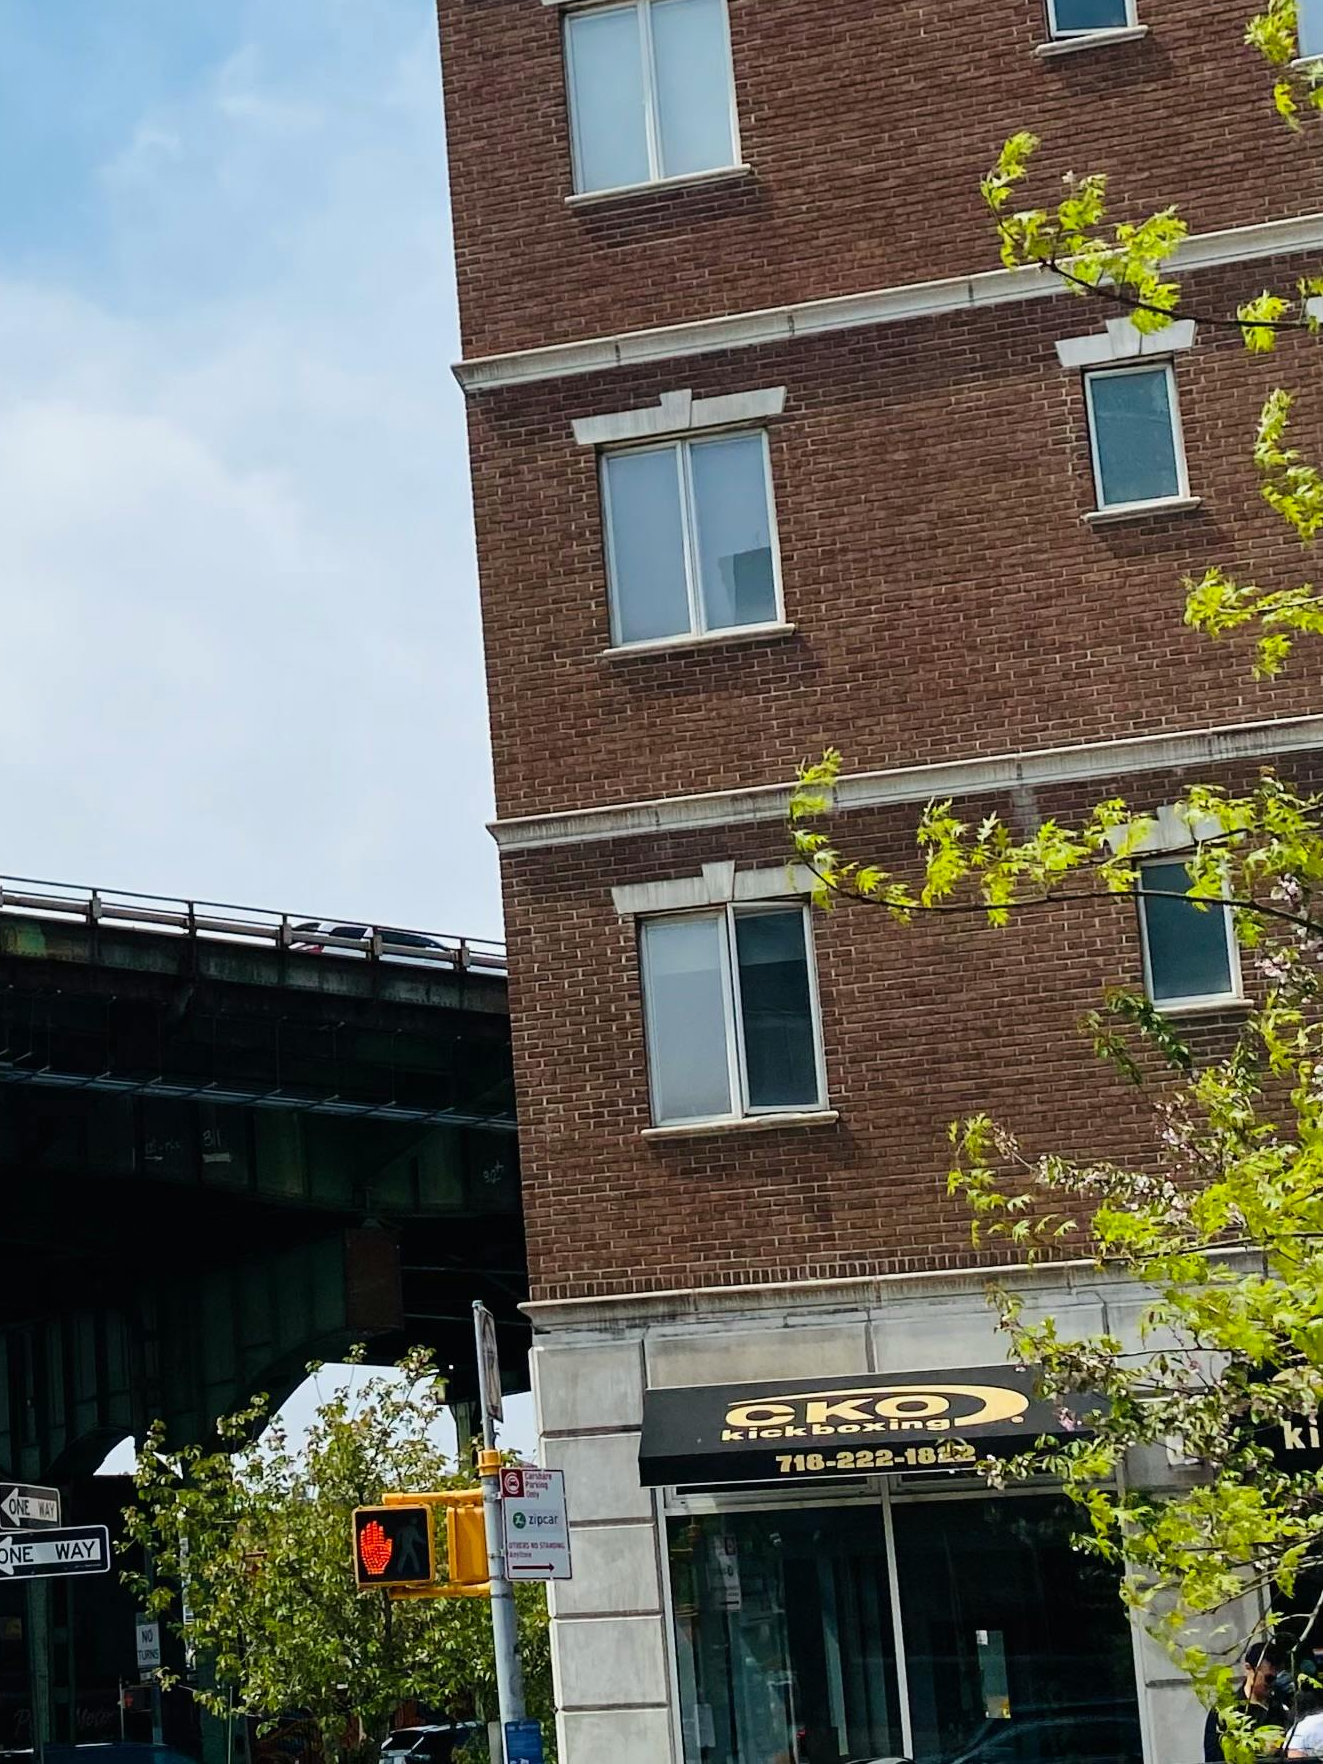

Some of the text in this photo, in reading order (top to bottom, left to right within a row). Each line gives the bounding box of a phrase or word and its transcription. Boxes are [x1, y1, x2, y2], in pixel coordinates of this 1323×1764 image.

[725, 1394, 950, 1428] CKO
[721, 1418, 951, 1442] kickboxing
[525, 1481, 548, 1490] Parking
[8, 1498, 55, 1518] ONE WAY
[528, 1514, 559, 1528] zipcar
[55, 1540, 96, 1560] WAY
[141, 1628, 154, 1644] NO
[138, 1649, 159, 1660] TURNS
